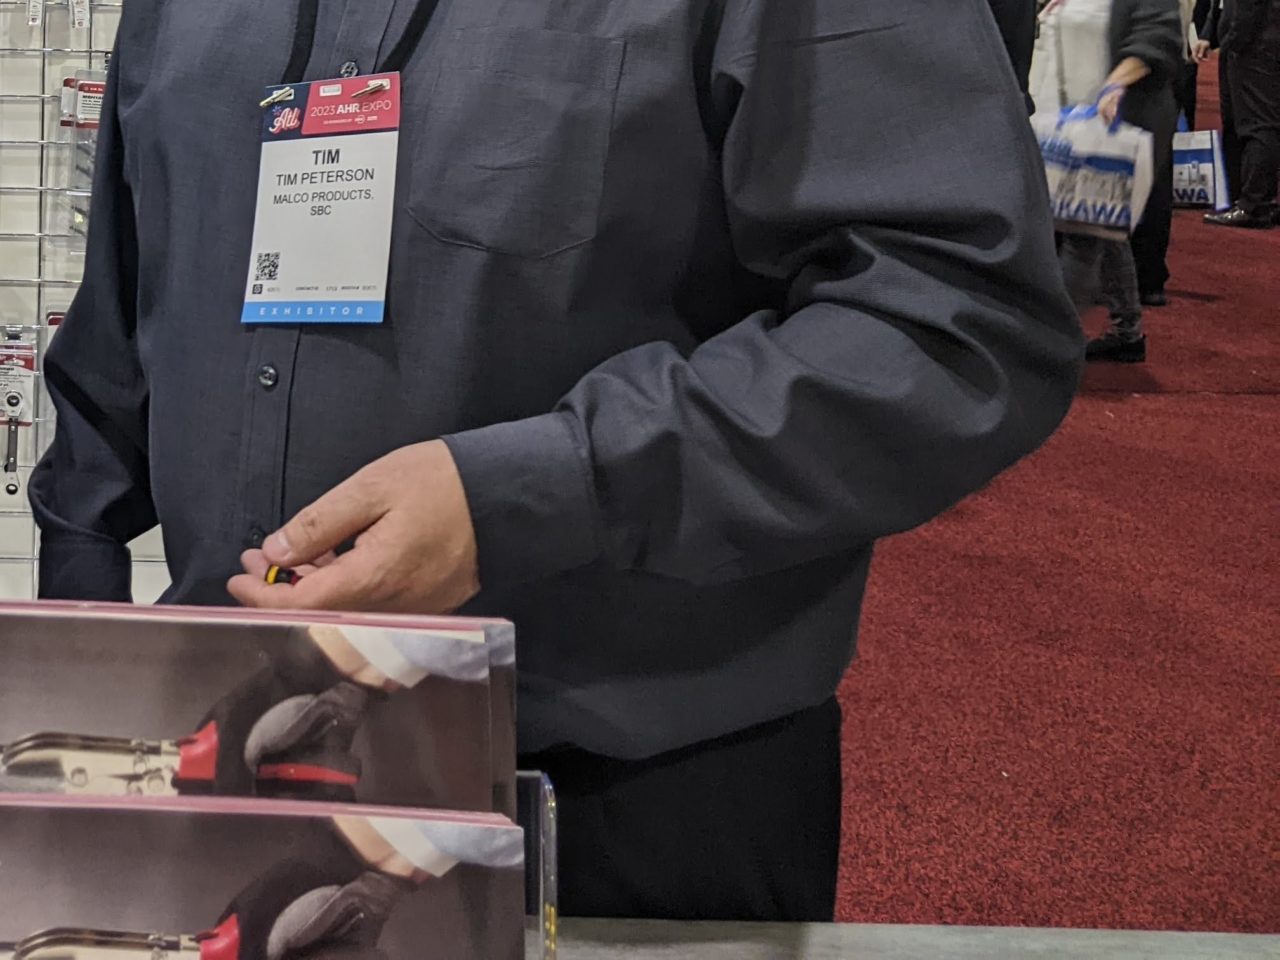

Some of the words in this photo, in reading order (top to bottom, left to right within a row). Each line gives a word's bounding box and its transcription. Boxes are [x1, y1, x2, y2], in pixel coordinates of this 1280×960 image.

[311, 104, 336, 116] 2023
[336, 100, 360, 114] AHR
[362, 100, 392, 113] EXPO
[312, 149, 340, 166] TIM
[276, 173, 297, 186] TIM
[301, 168, 375, 185] PETERSON
[273, 192, 309, 204] MALCO
[310, 205, 332, 216] SBC
[259, 307, 364, 316] EXHIBITOR
